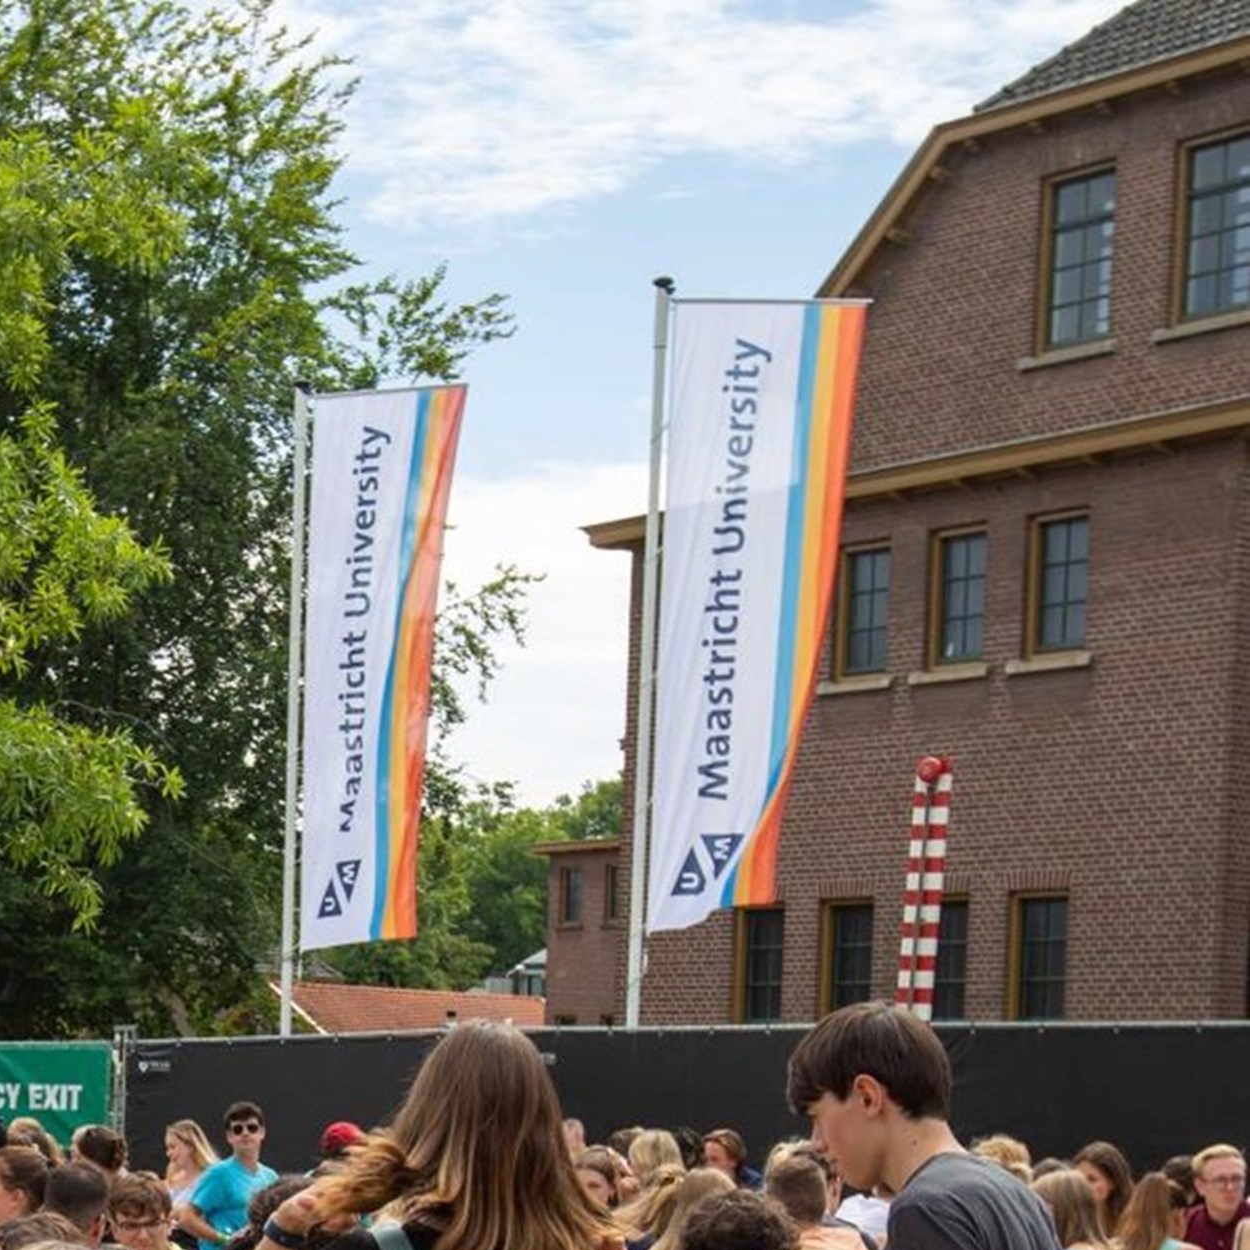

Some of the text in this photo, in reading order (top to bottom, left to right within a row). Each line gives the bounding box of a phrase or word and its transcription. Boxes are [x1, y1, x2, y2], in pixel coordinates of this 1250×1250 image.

[338, 425, 392, 832] Maastricht University
[696, 338, 772, 800] Maastricht University
[28, 1084, 83, 1111] EXIT
